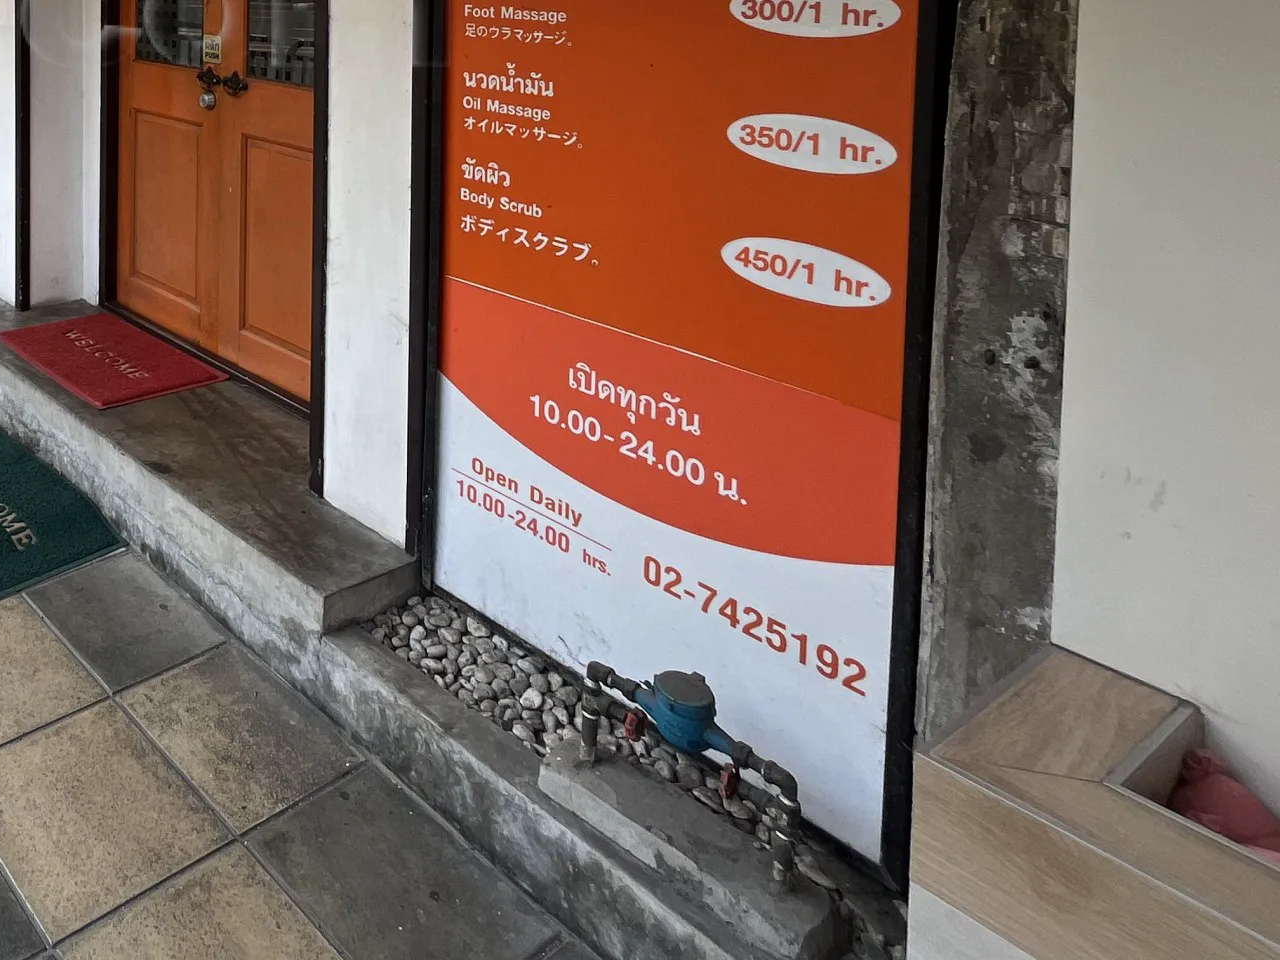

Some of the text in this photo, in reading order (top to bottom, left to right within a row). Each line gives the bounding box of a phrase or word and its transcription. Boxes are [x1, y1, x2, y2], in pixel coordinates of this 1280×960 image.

[464, 5, 567, 23] Foot Massage
[842, 2, 884, 28] hr.
[463, 63, 554, 97] นวดน้ำมัน
[462, 96, 551, 121] Oil Massage
[739, 124, 882, 165] 350/1 hr.
[461, 157, 511, 188] ขัดผิว
[460, 188, 542, 218] Body Scrub
[734, 246, 876, 302] 450/1 hr.
[64, 328, 149, 380] WELCOME
[568, 361, 701, 437] เปิดทุกวัน
[528, 393, 748, 506] 10.00-24.00 น.
[471, 457, 583, 528] Open Daily
[455, 479, 612, 578] 10.00-24.00 hrs.
[643, 555, 867, 697] 02-7425192
